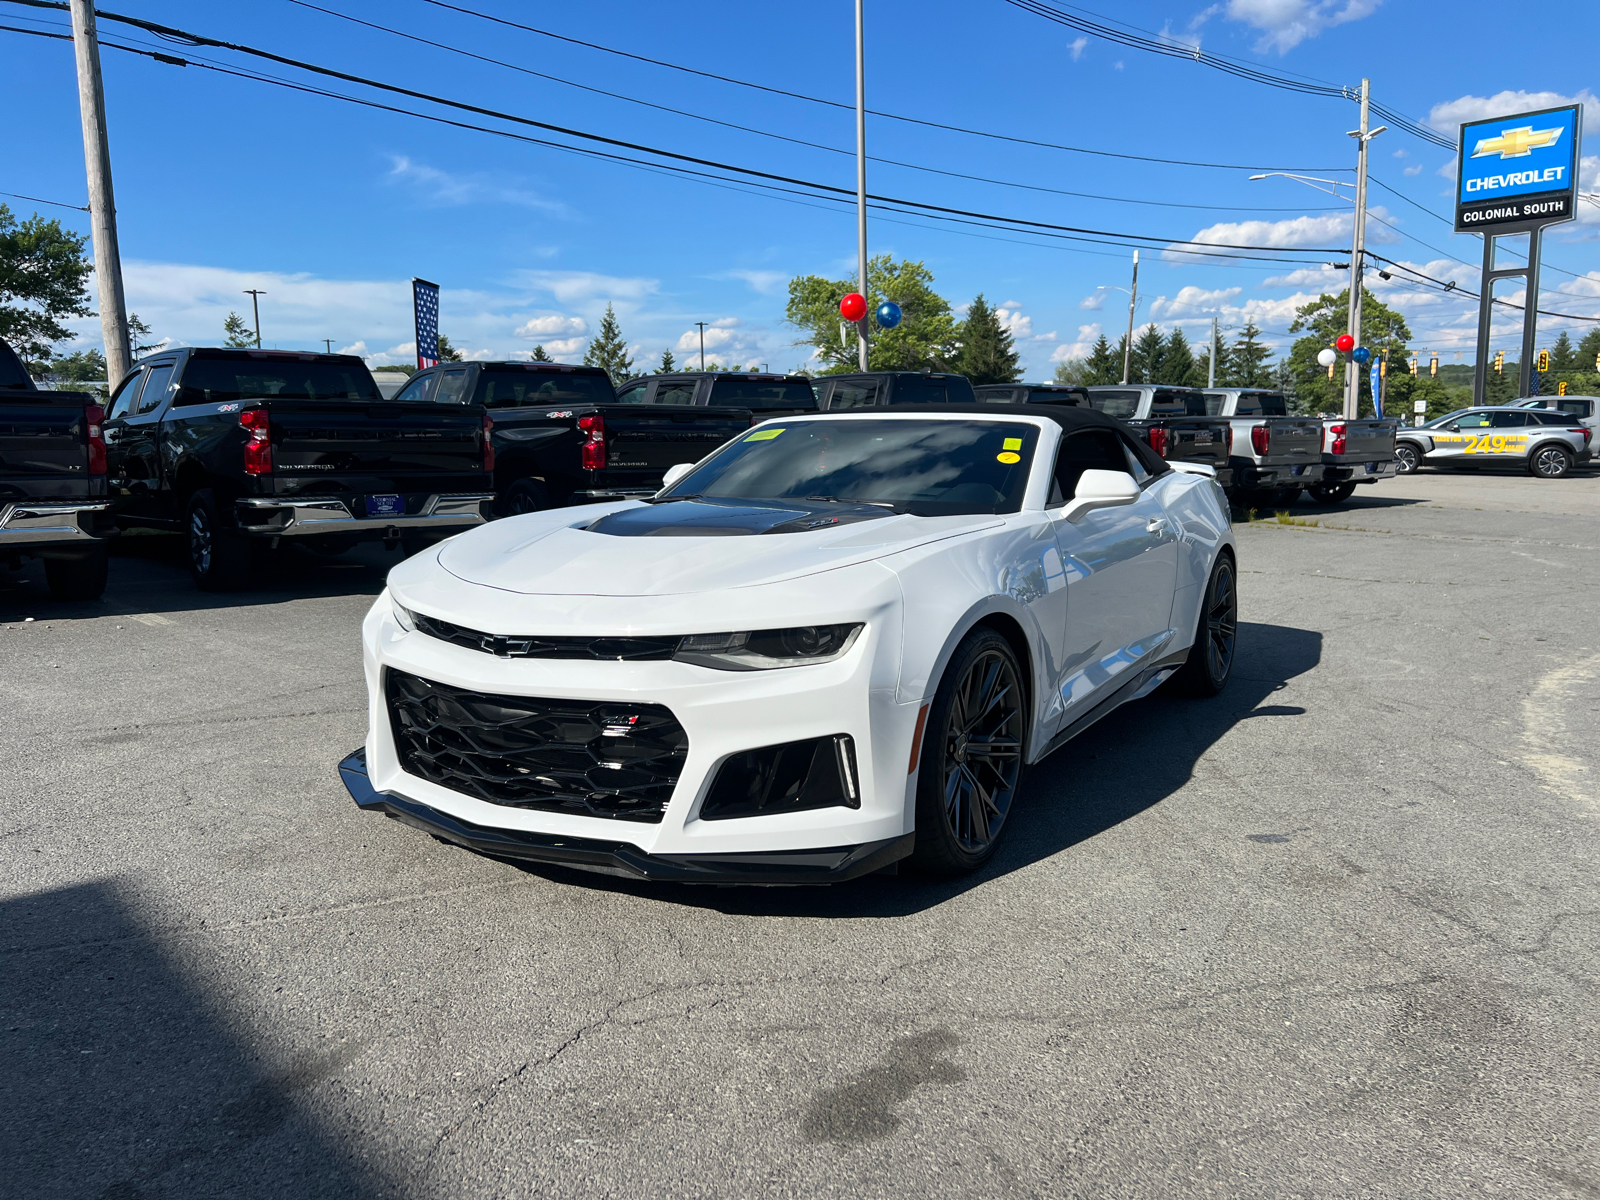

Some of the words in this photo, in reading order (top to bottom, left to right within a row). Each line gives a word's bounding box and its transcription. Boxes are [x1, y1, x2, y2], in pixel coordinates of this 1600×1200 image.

[1466, 166, 1565, 192] CHEVROLET
[1463, 207, 1520, 222] COLONIAL
[1523, 201, 1564, 215] SOUTH
